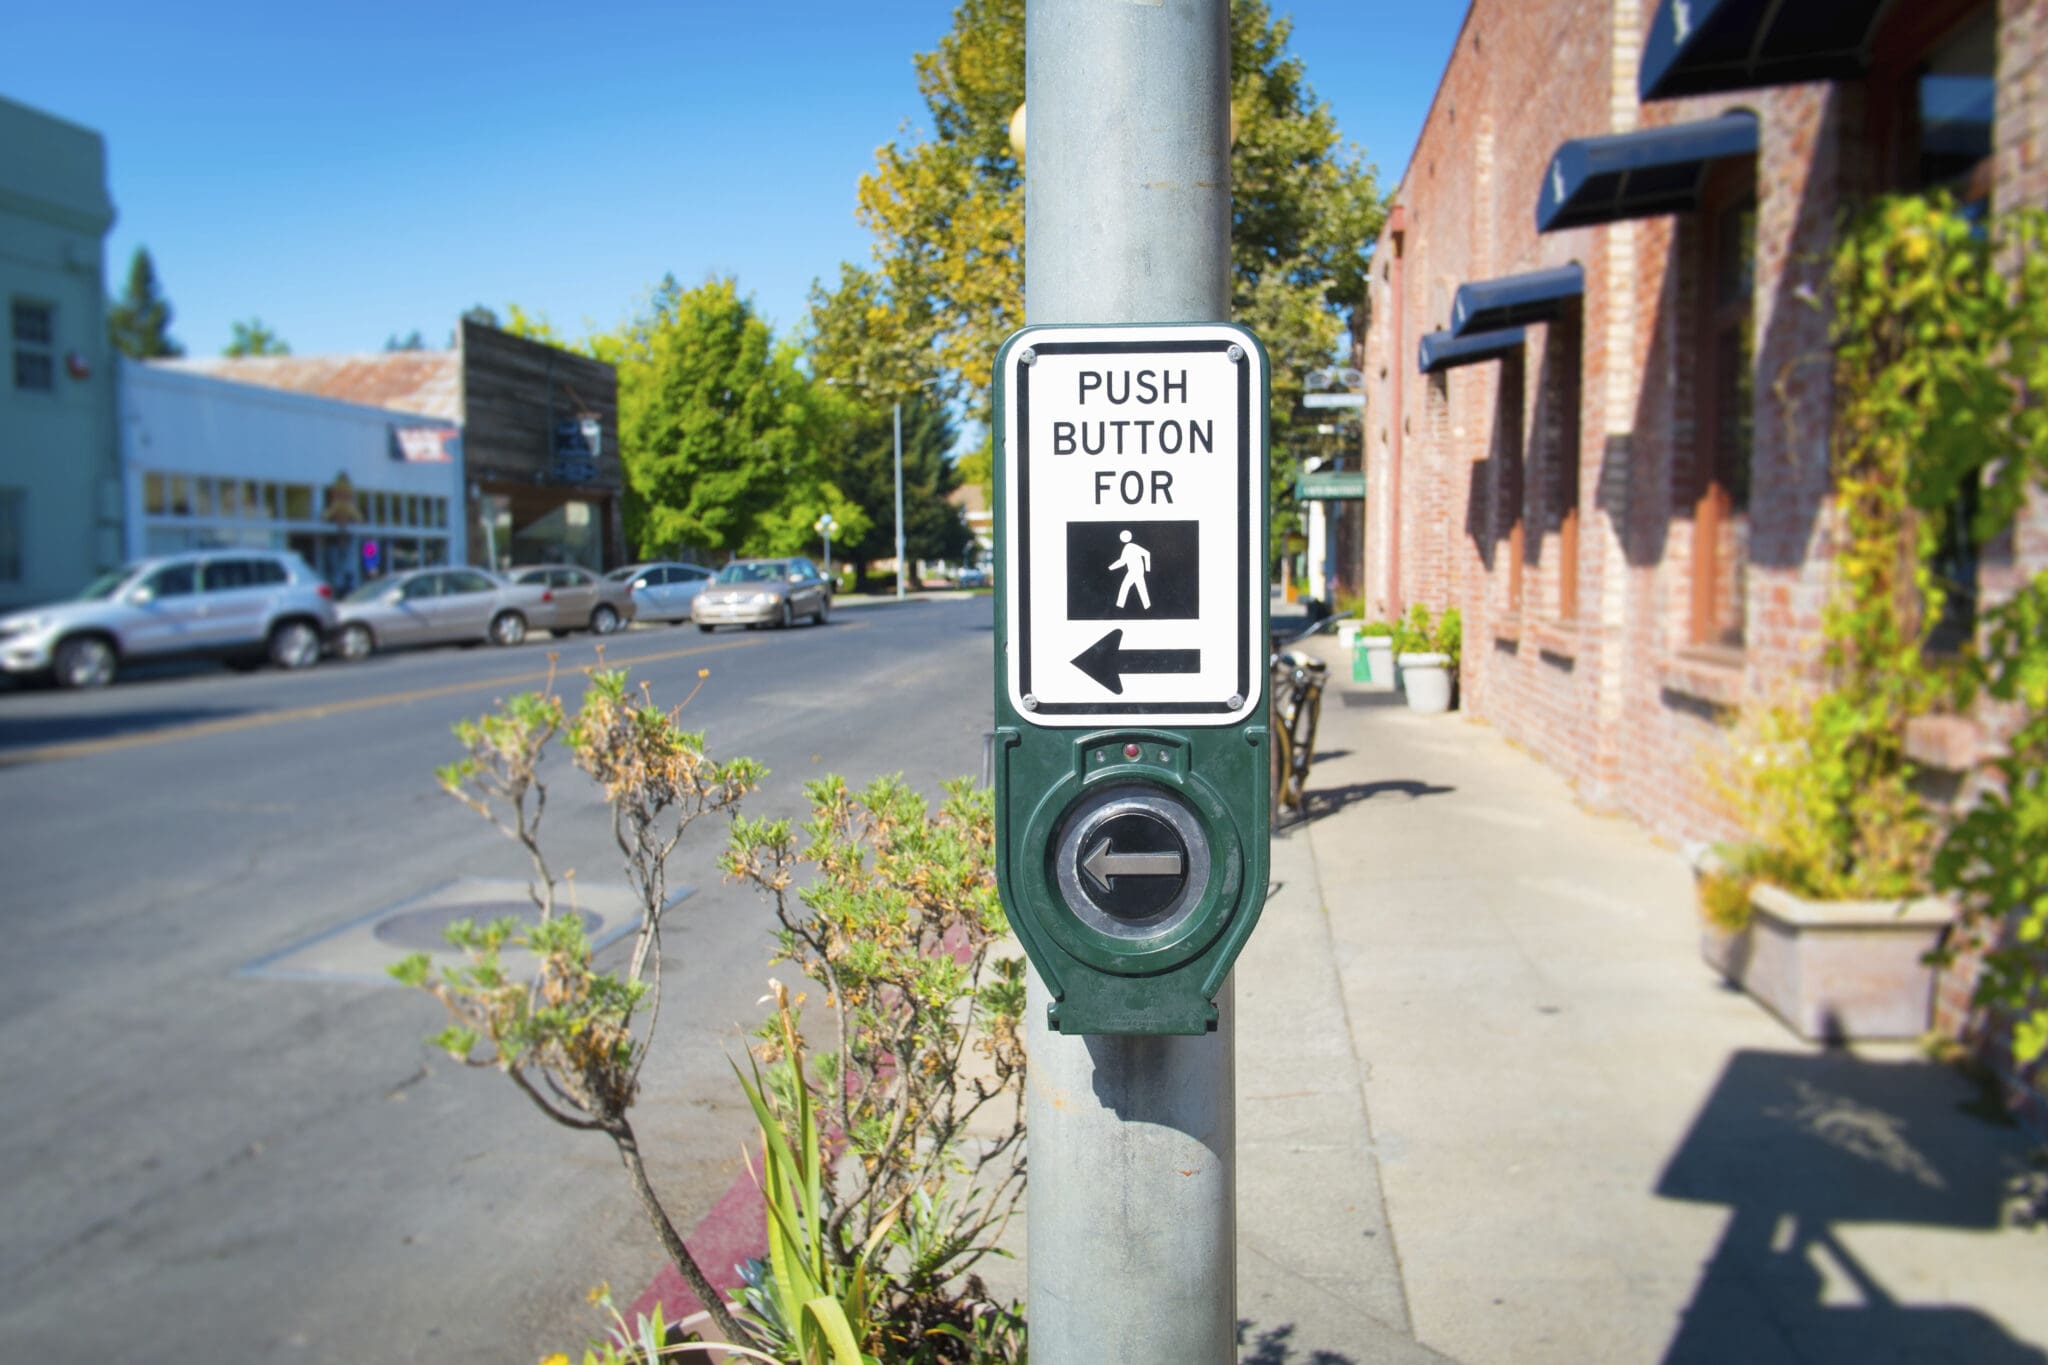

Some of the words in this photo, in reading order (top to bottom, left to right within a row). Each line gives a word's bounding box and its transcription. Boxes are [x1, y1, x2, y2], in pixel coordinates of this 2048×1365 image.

[1079, 369, 1187, 405] PUSH
[1053, 420, 1213, 456] BUTTON
[1095, 470, 1174, 505] FOR
